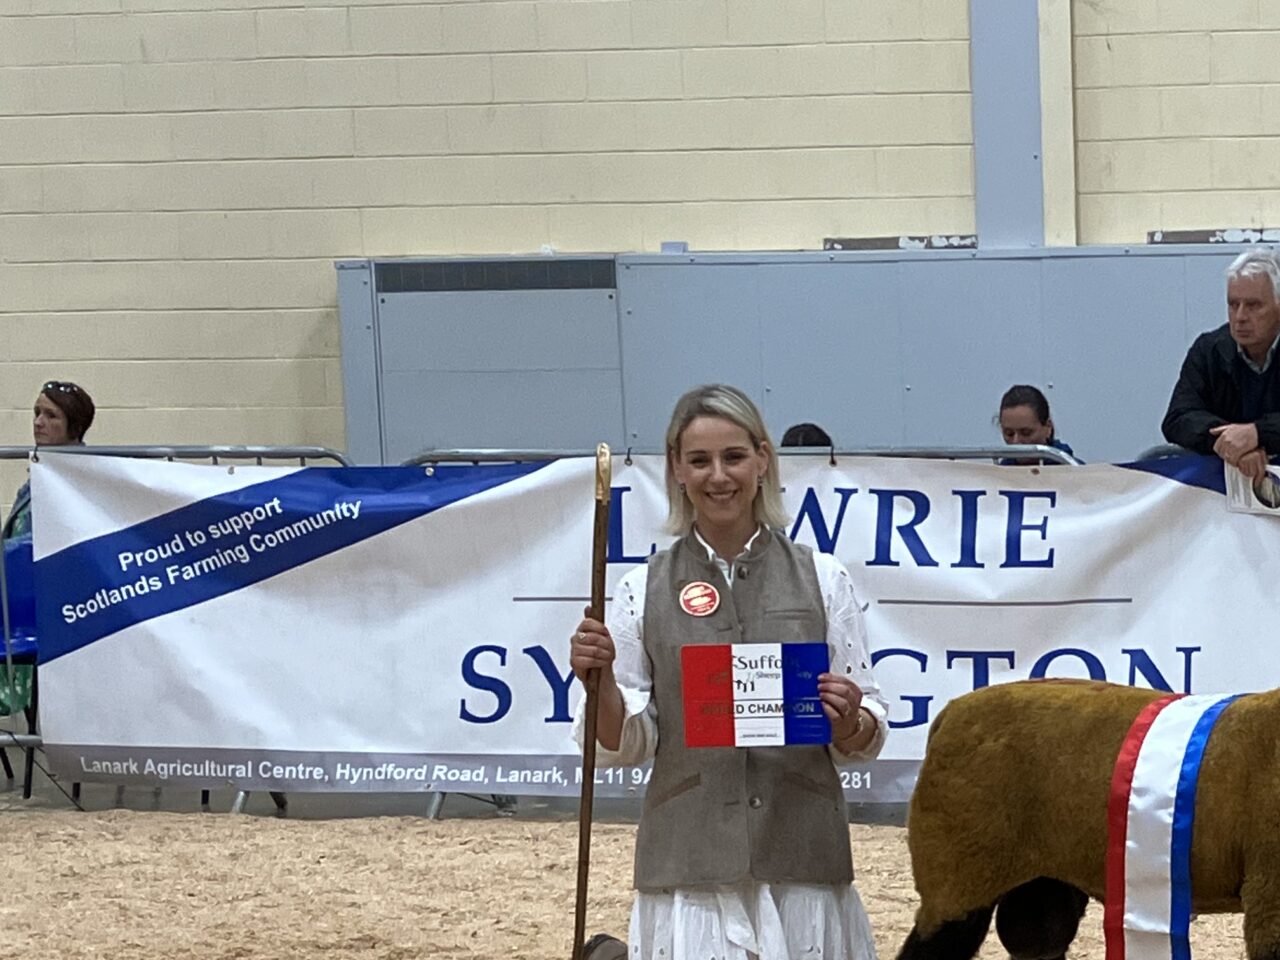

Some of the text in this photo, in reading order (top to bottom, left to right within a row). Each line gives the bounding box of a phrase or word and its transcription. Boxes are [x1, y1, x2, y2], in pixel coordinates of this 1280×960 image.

[61, 499, 362, 624] Scotlands Farming Community
[118, 496, 283, 571] Proud to support
[606, 486, 1057, 568] LWRIE
[80, 757, 139, 775] Lanark
[143, 758, 252, 779] Agricultural
[258, 761, 329, 781] Centre,
[335, 763, 426, 785] Hyndford
[432, 764, 489, 784] Road,
[495, 766, 568, 787] Lanark,
